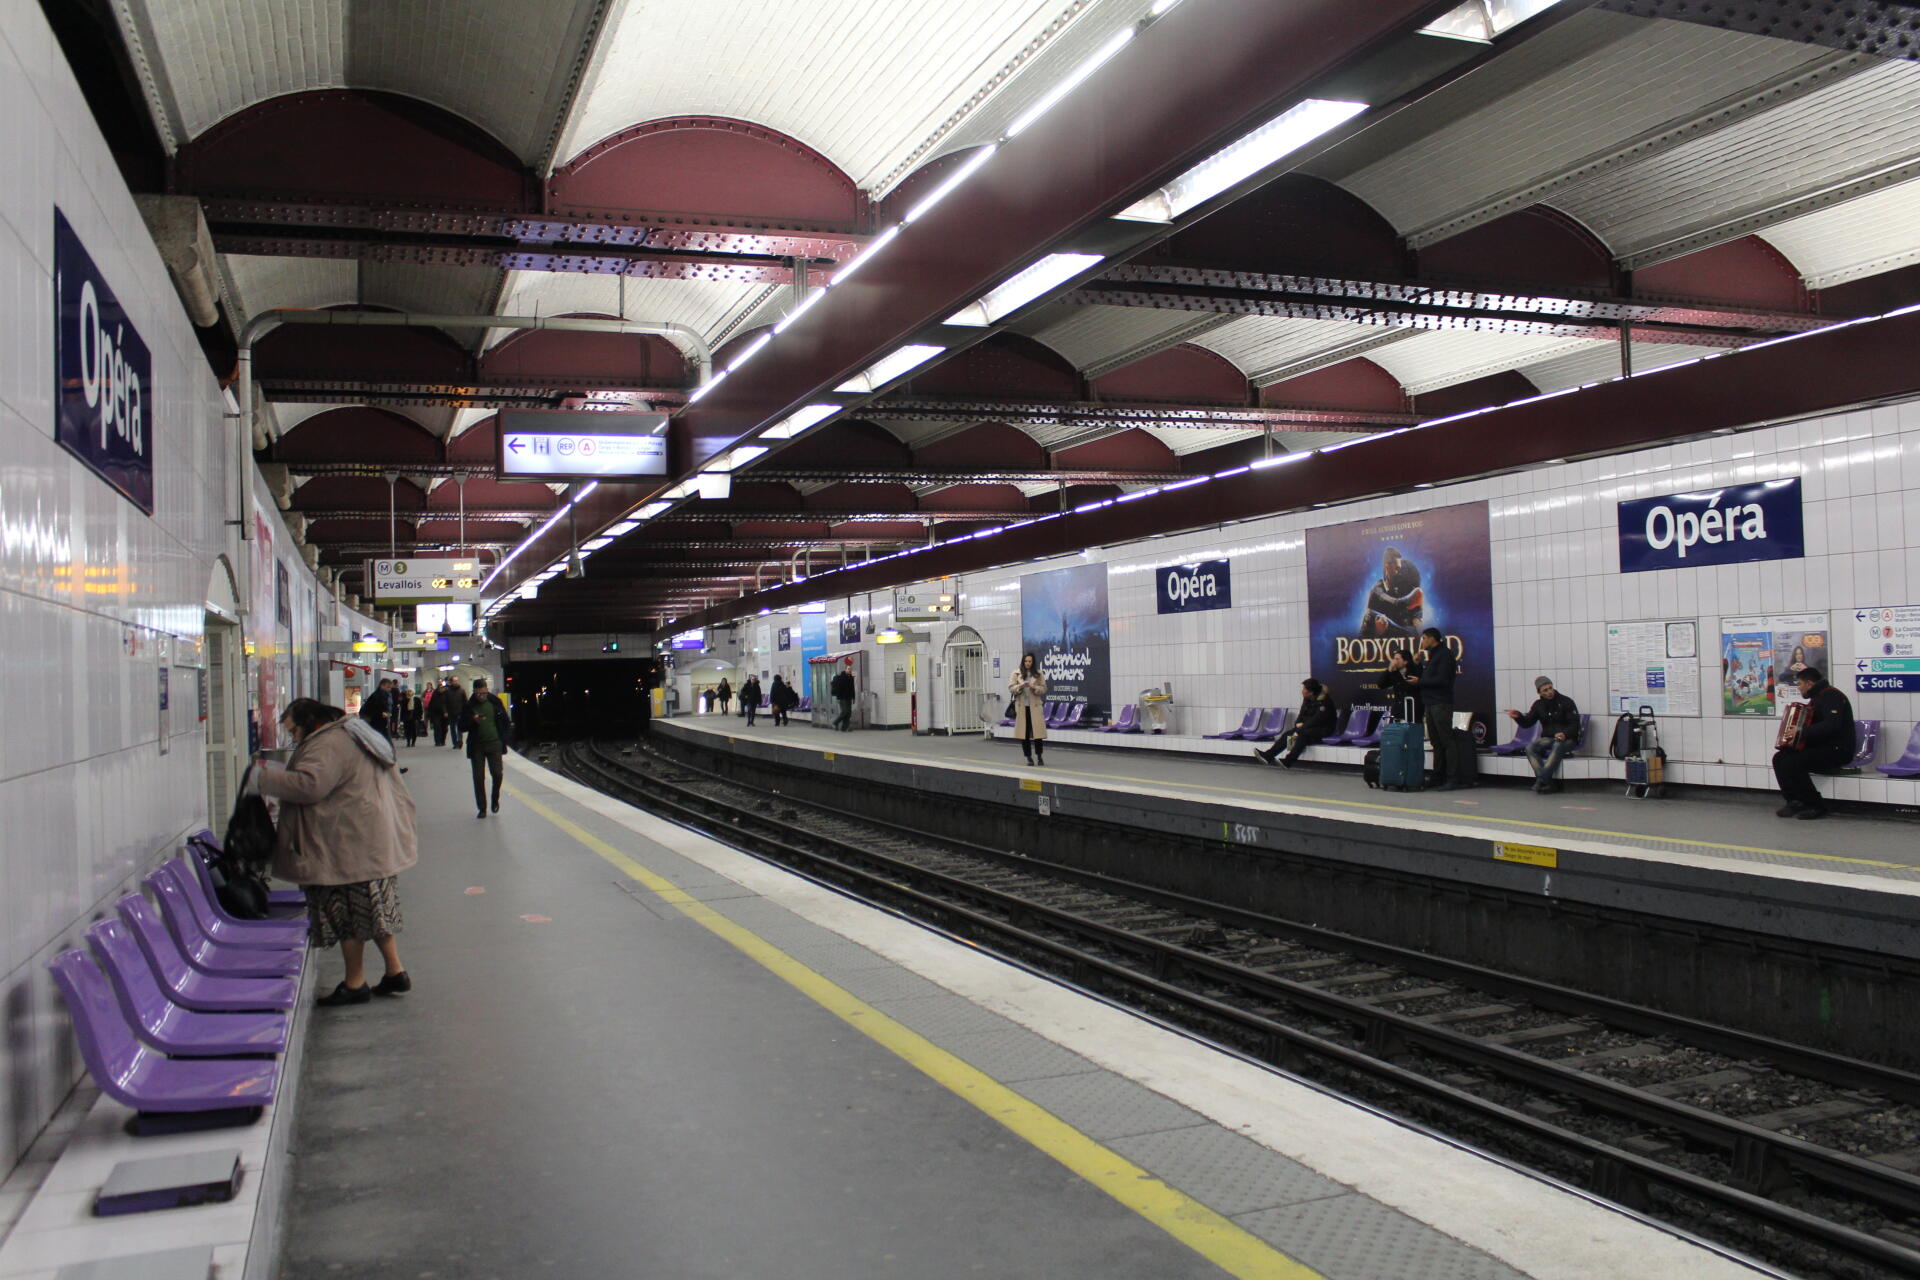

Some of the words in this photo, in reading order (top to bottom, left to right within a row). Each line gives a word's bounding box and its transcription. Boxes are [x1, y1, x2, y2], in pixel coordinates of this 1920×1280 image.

[80, 280, 143, 457] Opéra
[1646, 497, 1767, 558] Opéra
[377, 579, 422, 589] Levallois
[1168, 568, 1217, 606] Opéra
[1336, 635, 1464, 665] BODYGUAD
[1871, 677, 1904, 689] Sortie
